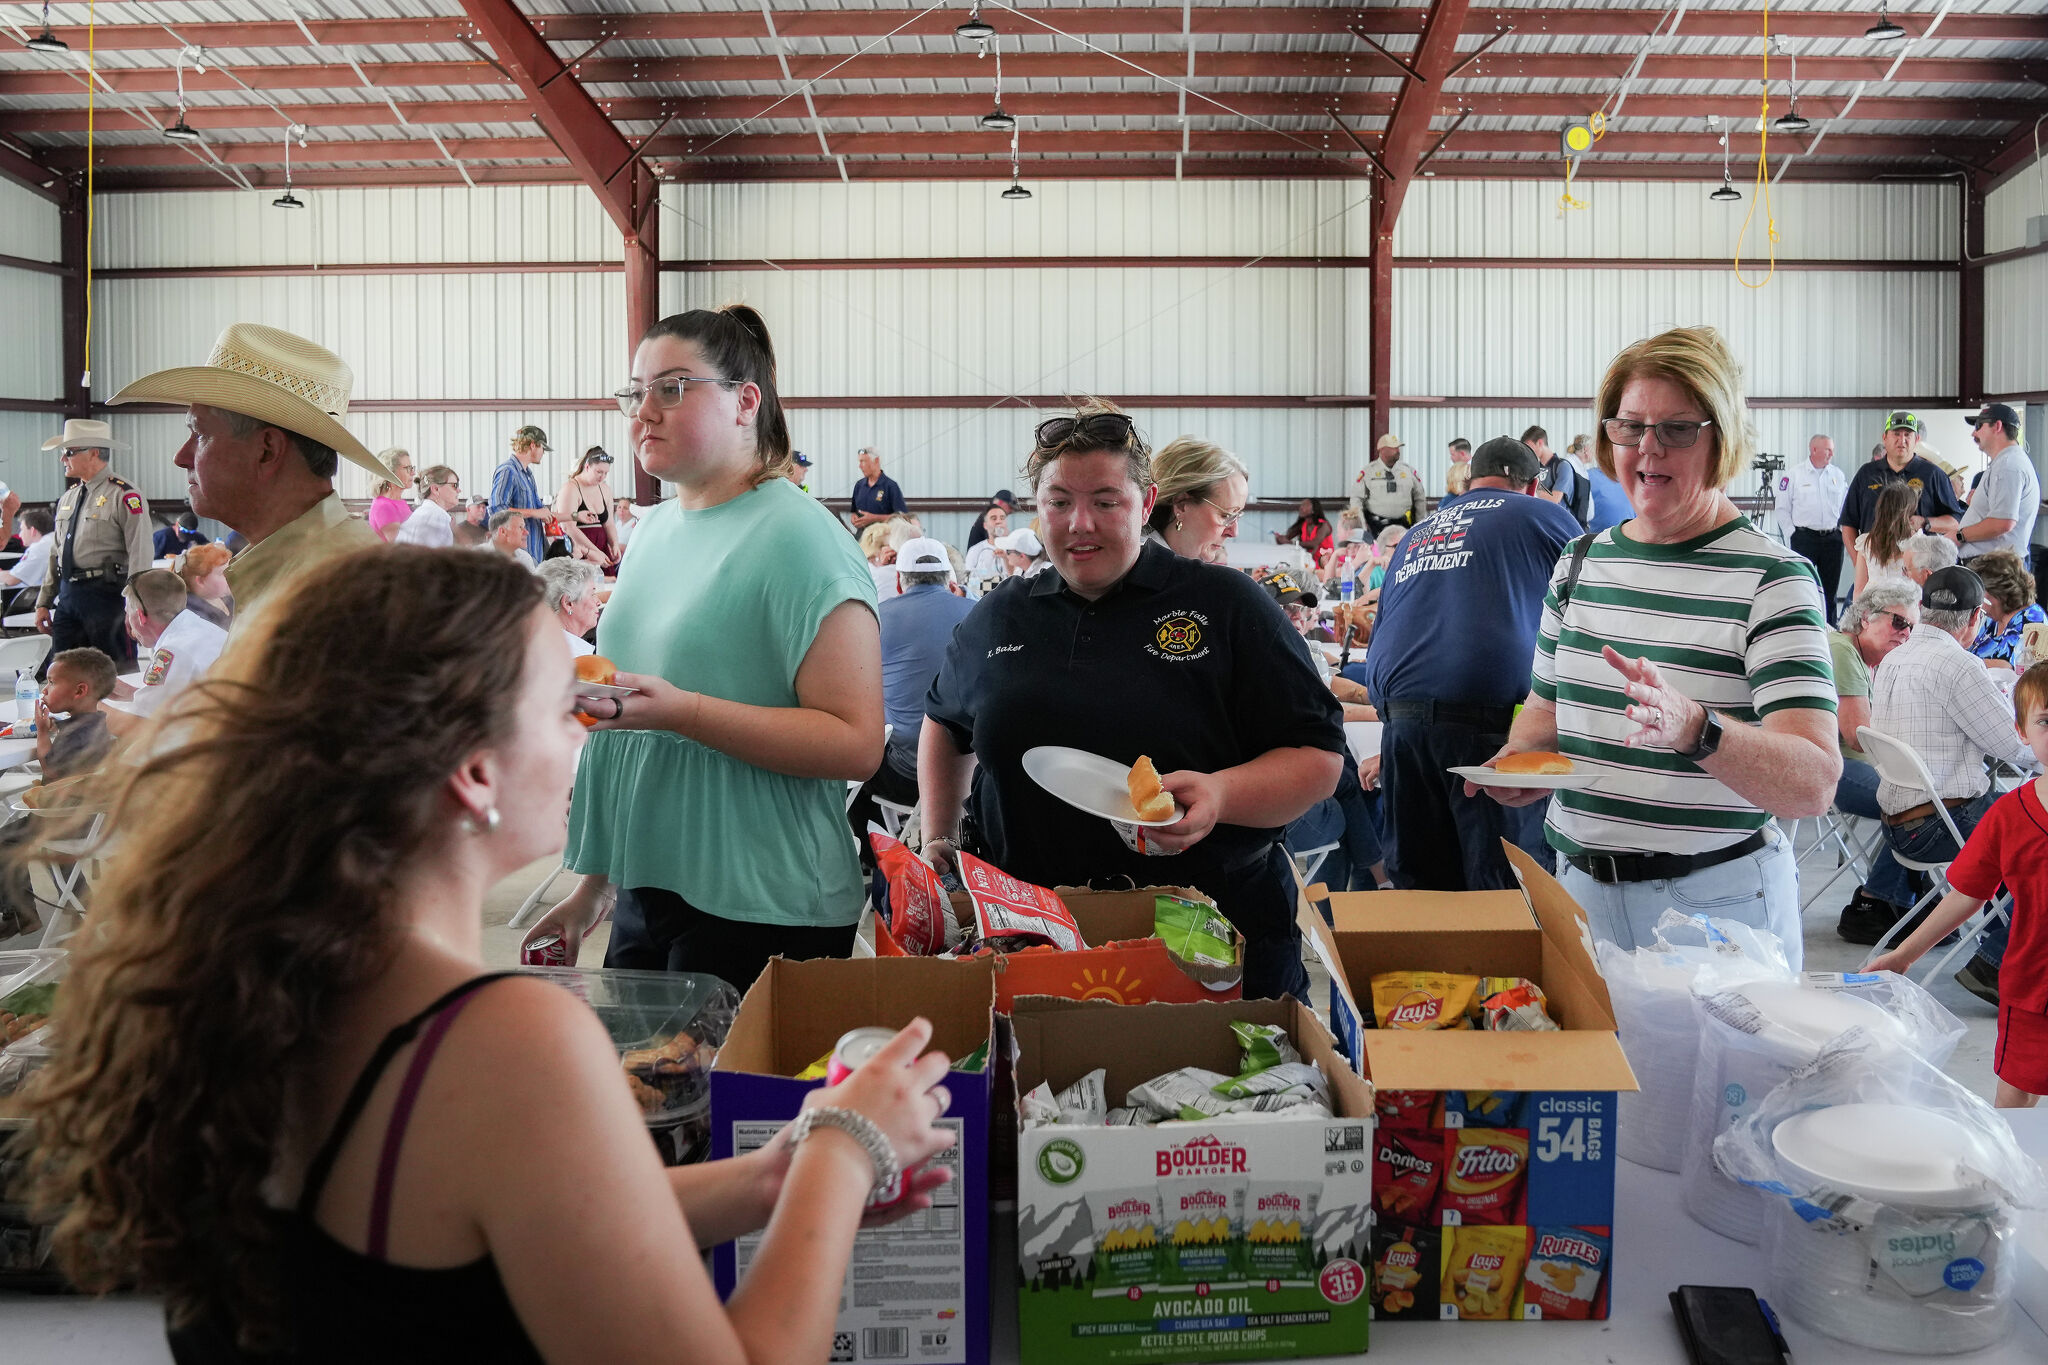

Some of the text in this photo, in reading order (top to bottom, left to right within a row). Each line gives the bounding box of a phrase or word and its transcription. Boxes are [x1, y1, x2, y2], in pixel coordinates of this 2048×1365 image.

[1461, 499, 1505, 510] FALLS
[1430, 511, 1463, 525] AREA
[1404, 517, 1474, 565] FIRE
[1394, 551, 1474, 585] DEPARTMENT
[1153, 610, 1187, 625] Marble
[1189, 610, 1209, 626] Falls
[995, 644, 1025, 655] Baker
[1143, 643, 1210, 663] Fire Department
[1393, 999, 1438, 1024] Lay's
[1539, 1097, 1602, 1113] classic
[1451, 1114, 1458, 1124] 7
[1537, 1117, 1587, 1162] 54
[1587, 1118, 1602, 1161] BAGS
[1156, 1147, 1248, 1178] BOULDER
[1379, 1147, 1434, 1174] Doritos
[1456, 1145, 1520, 1178] Fritos
[1177, 1166, 1227, 1176] CANYON
[1108, 1202, 1152, 1219] BOULDER
[1181, 1194, 1227, 1211] BOULDER
[1258, 1196, 1301, 1211] BOULDER
[1449, 1211, 1455, 1222] 7
[1537, 1235, 1601, 1265] RUFFLES
[1887, 1233, 1956, 1254] Plates
[1386, 1251, 1417, 1266] Lay's
[1470, 1254, 1501, 1270] Lay's
[1198, 1284, 1207, 1295] 14
[1328, 1271, 1356, 1296] 36
[1130, 1287, 1139, 1299] 12
[1152, 1297, 1253, 1318] AVOCADO OIL
[1529, 1305, 1536, 1315] 4
[1175, 1317, 1230, 1330] CLASSIC SEA SALT
[1247, 1316, 1259, 1326] SEA
[1260, 1315, 1274, 1325] SALT
[1307, 1311, 1330, 1322] PEPPER
[1078, 1325, 1096, 1335] SPICY
[1098, 1324, 1118, 1333] GREEN
[1119, 1323, 1136, 1333] CHILI
[1141, 1329, 1267, 1347] KETTLE STYLE POTATO CHIPS
